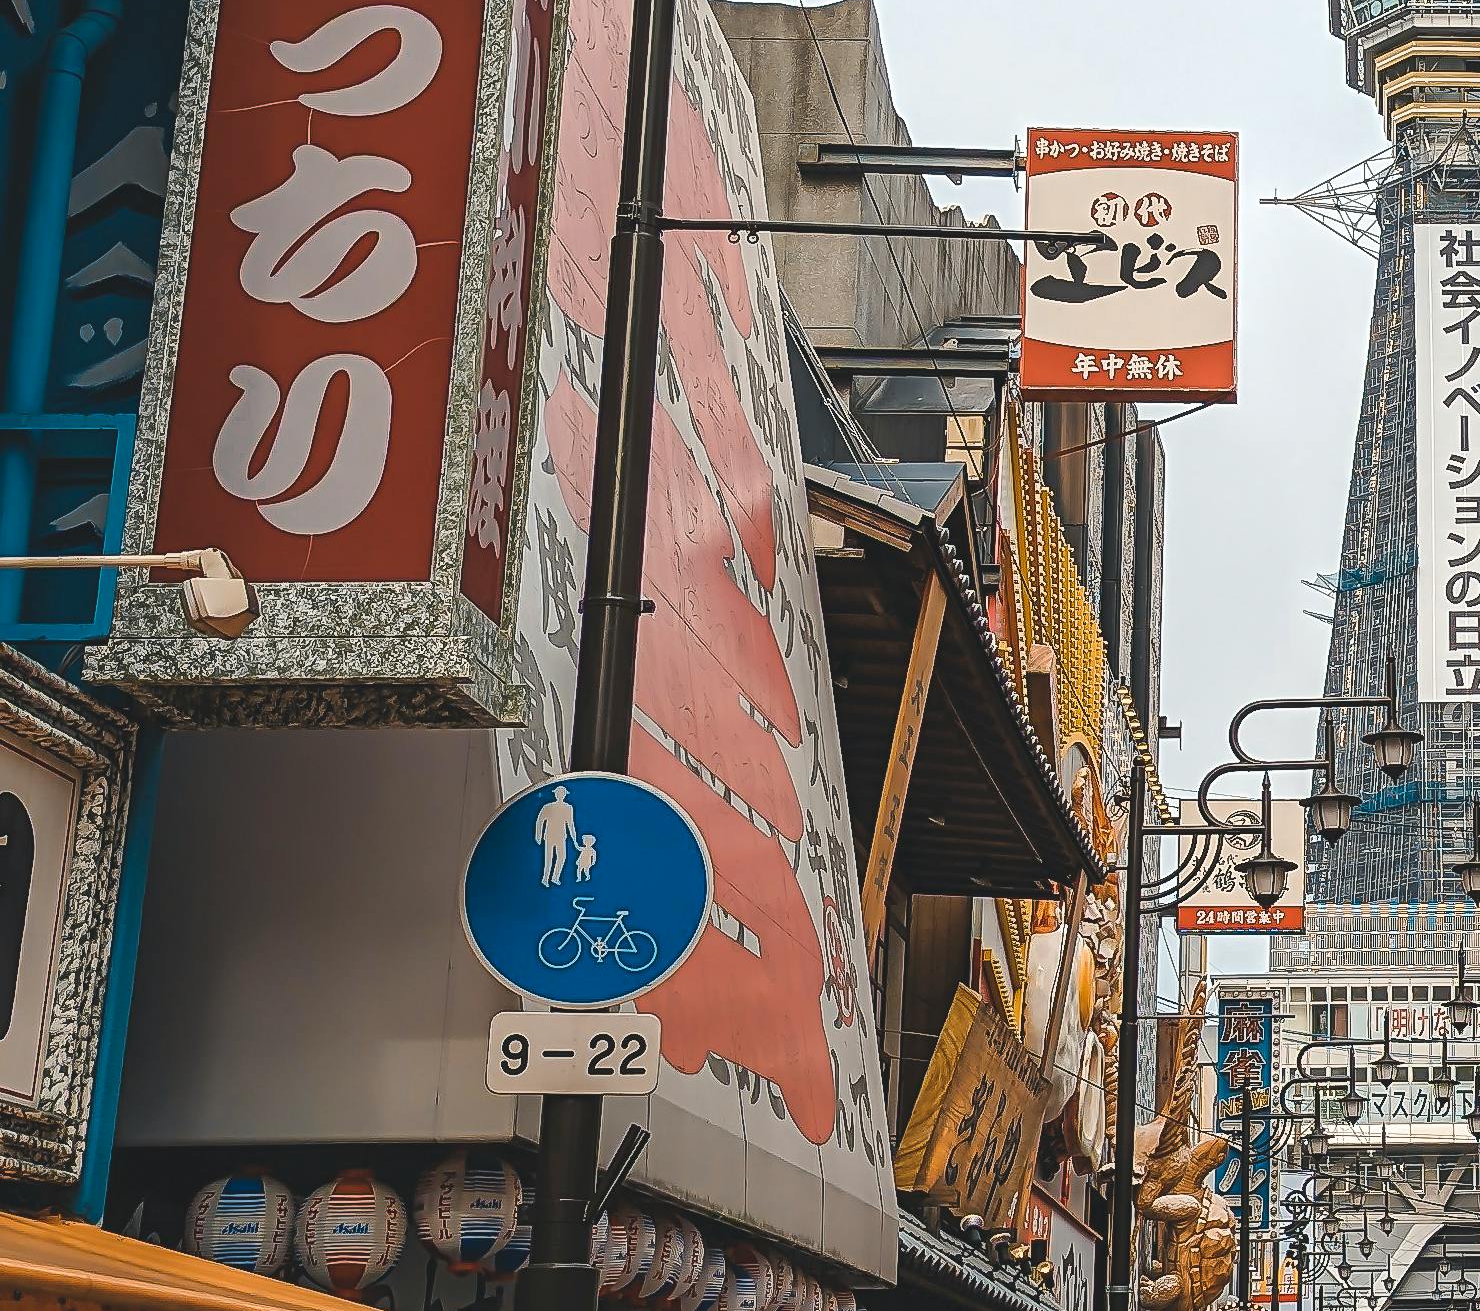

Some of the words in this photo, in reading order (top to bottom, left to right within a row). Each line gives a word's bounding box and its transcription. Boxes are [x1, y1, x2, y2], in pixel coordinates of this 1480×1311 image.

[1072, 353, 1183, 380] 年中無休
[1197, 910, 1284, 925] 24時間営業中
[1221, 1002, 1267, 1089] 麻雀
[221, 1222, 260, 1235] Asahi
[333, 1222, 370, 1235] Asahi
